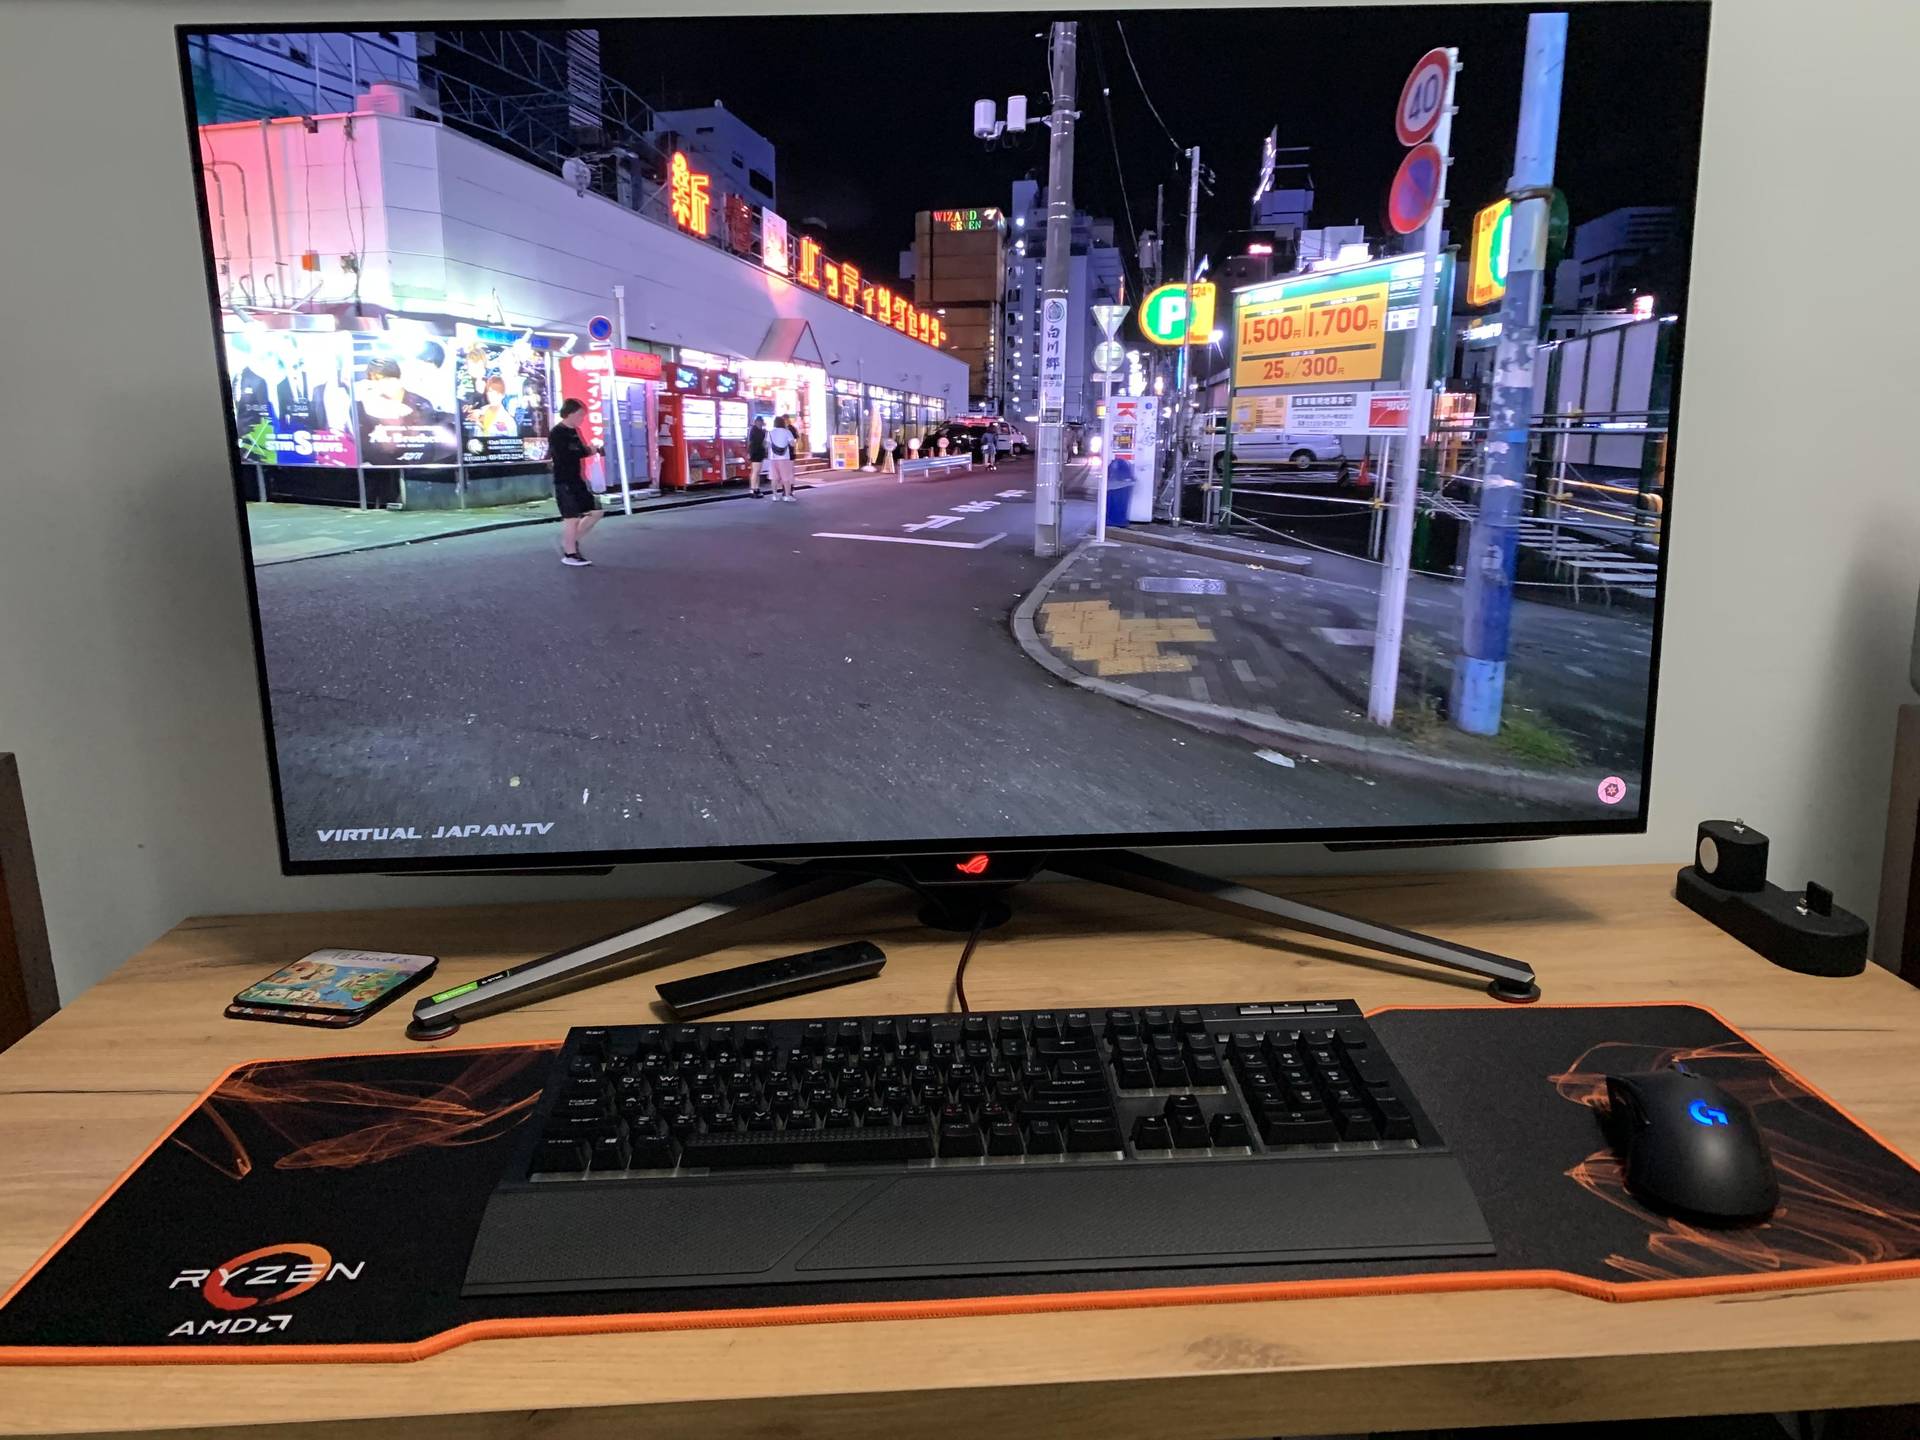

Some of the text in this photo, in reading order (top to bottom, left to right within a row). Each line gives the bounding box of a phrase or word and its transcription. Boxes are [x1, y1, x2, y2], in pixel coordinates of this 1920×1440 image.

[1409, 74, 1439, 121] 40
[672, 152, 709, 237] 新
[1159, 297, 1187, 334] P
[317, 822, 554, 841] VIRTUAL JAPAN.TV
[169, 1261, 366, 1289] RYZEN
[168, 1317, 259, 1337] AMD
